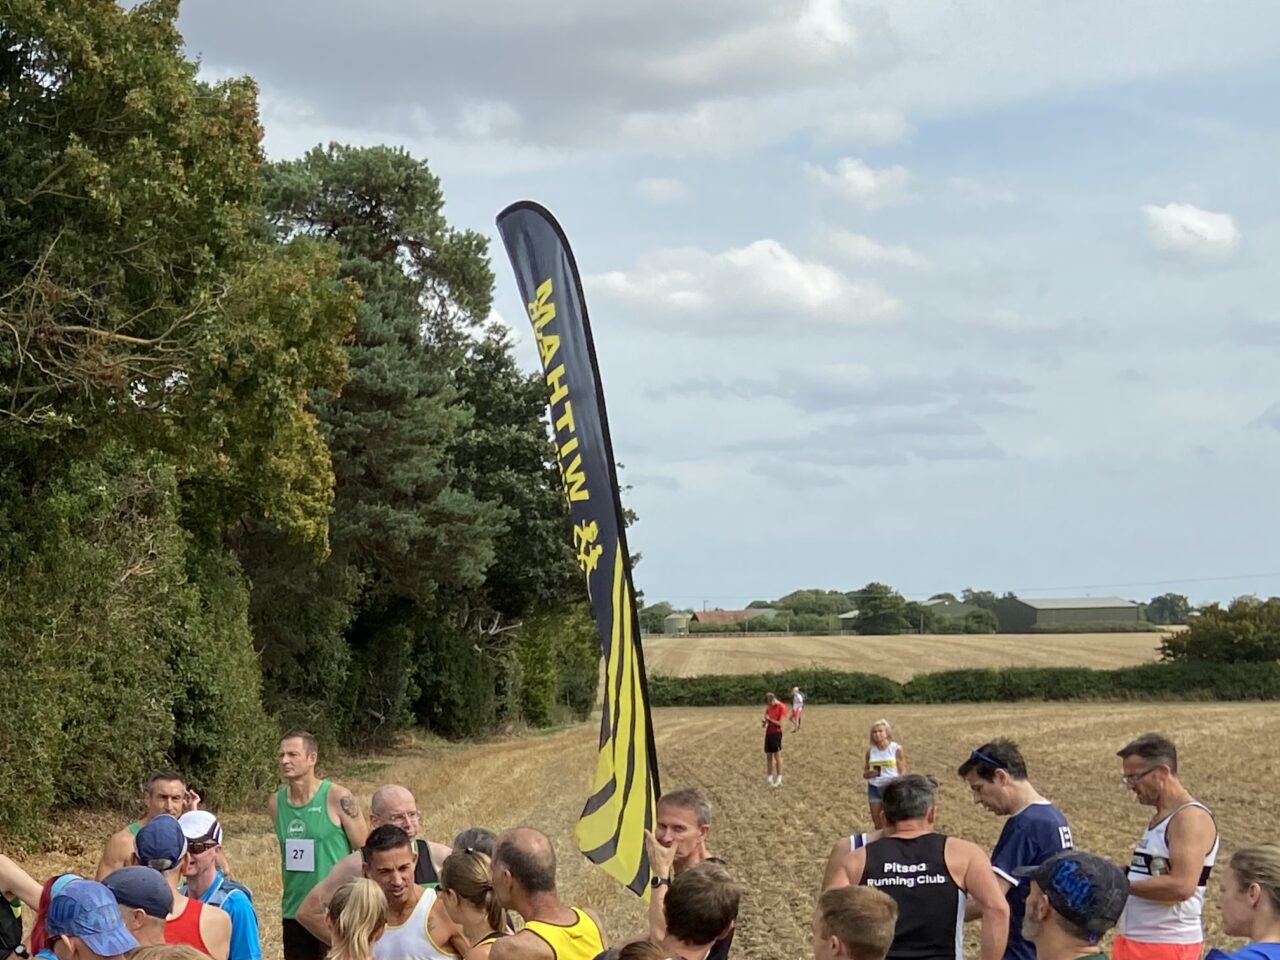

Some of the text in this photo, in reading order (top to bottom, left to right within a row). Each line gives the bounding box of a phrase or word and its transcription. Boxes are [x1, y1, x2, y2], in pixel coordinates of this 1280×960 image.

[292, 849, 305, 860] 27
[883, 862, 927, 874] Pitsea
[867, 874, 946, 888] Running Club
